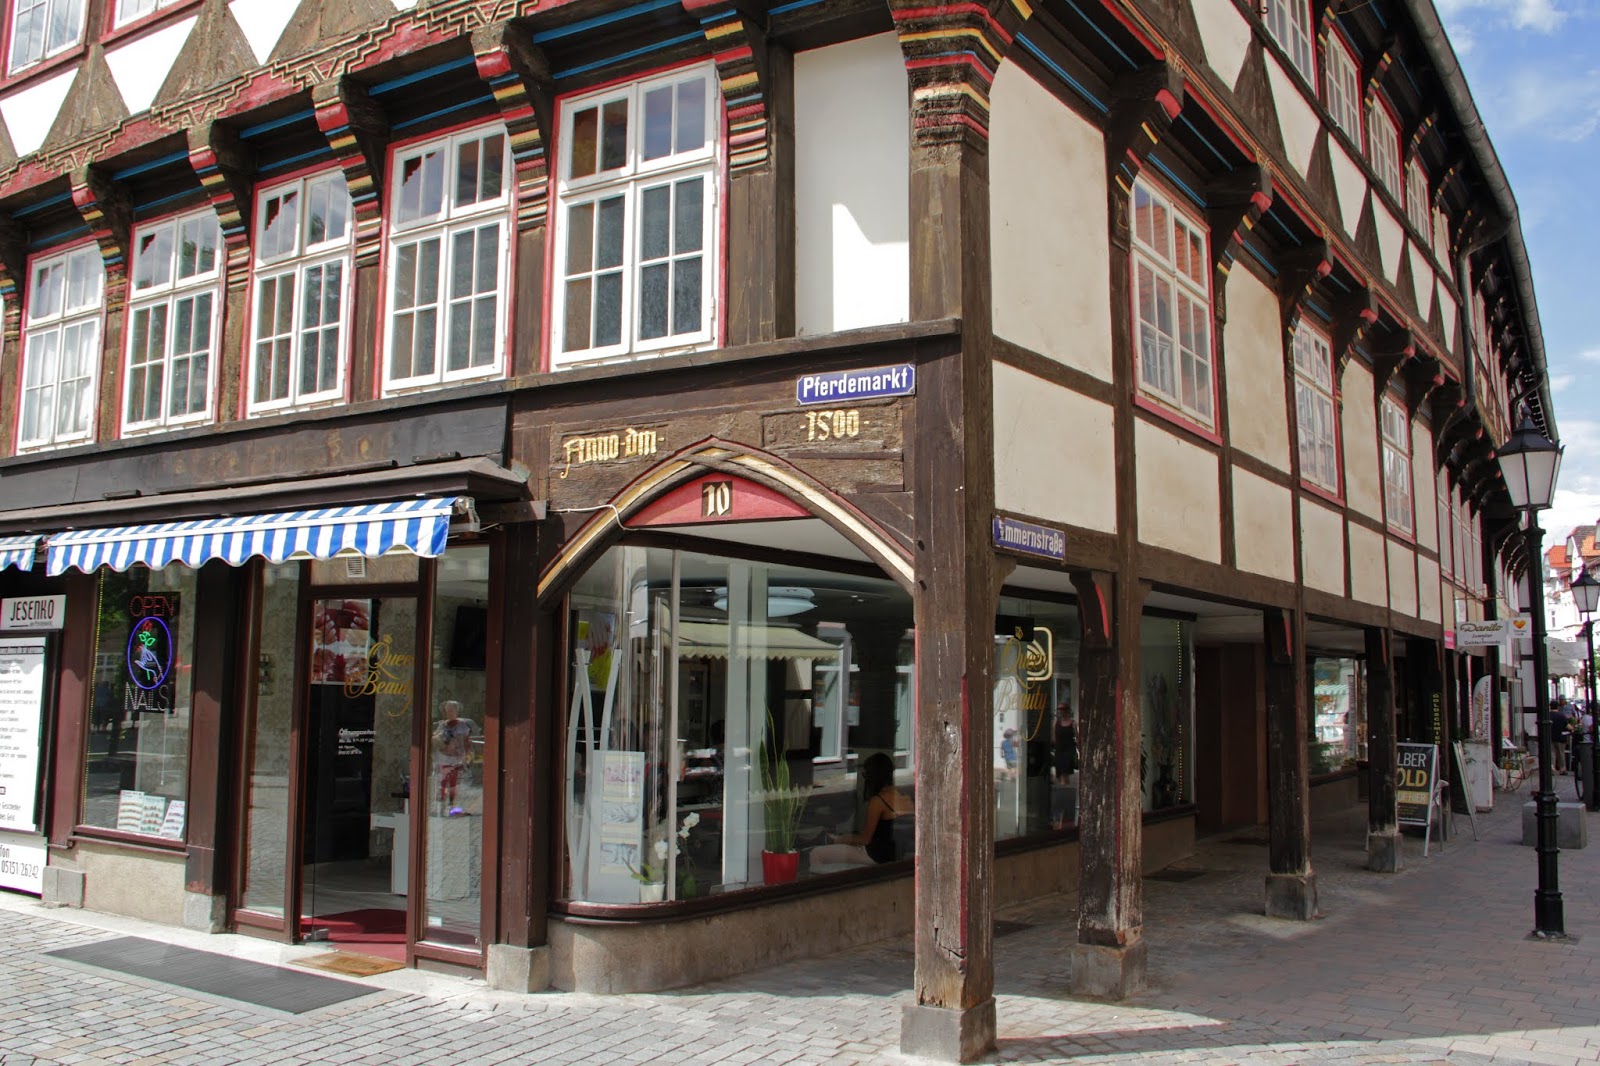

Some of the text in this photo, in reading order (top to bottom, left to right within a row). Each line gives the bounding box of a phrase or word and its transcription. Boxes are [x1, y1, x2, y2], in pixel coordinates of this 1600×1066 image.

[803, 367, 908, 398] Pferdemarkt
[702, 481, 730, 517] 10
[10, 599, 55, 621] JESENKO
[130, 595, 175, 617] OPEN
[1460, 622, 1503, 633] Danilo
[125, 681, 169, 712] NAILS
